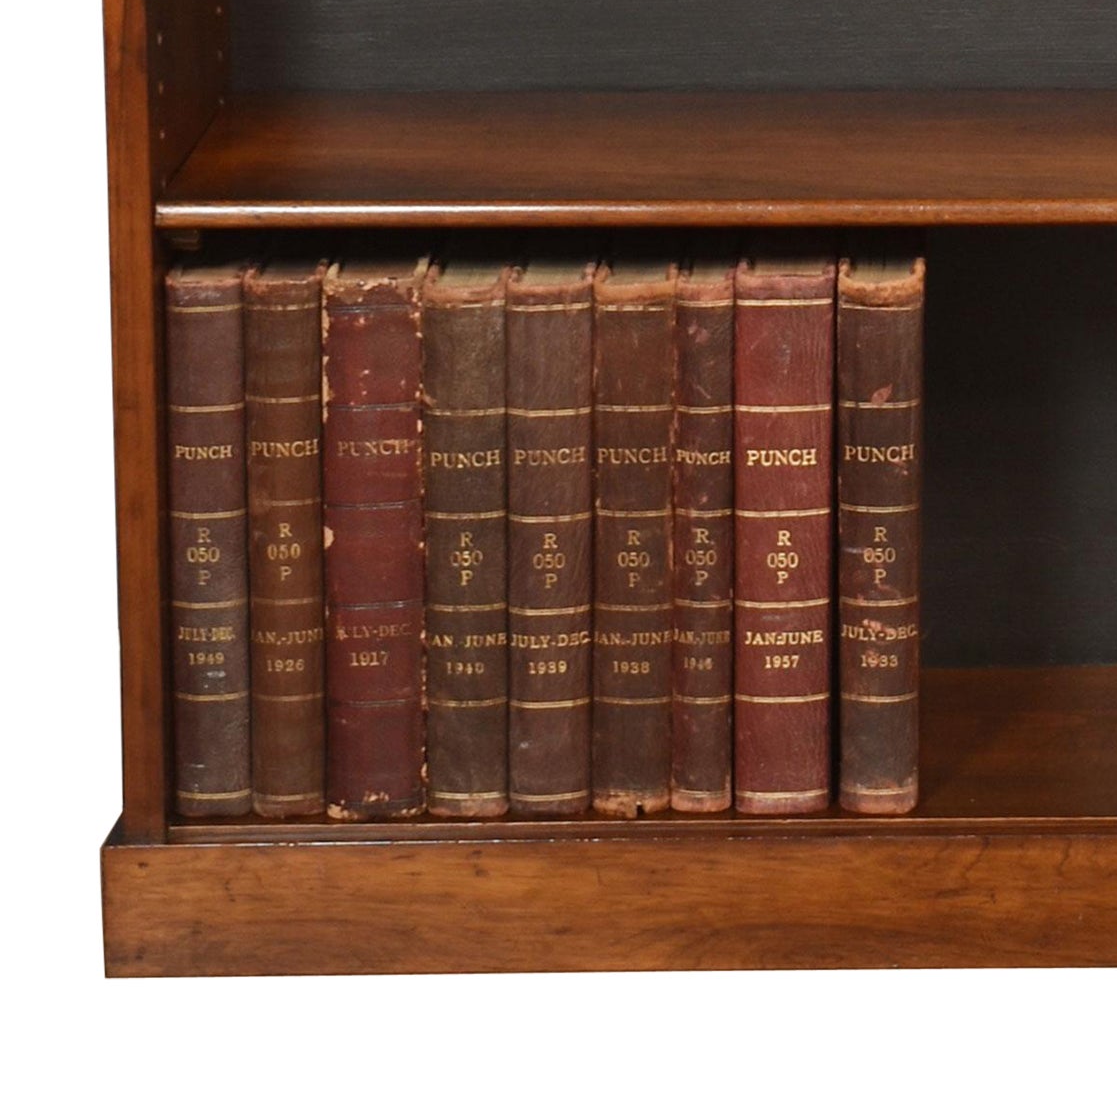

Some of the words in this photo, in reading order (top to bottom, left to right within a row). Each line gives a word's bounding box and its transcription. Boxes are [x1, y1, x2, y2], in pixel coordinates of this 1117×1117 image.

[175, 444, 232, 460] PUNCH
[251, 438, 319, 458] PUNCH
[337, 439, 410, 457] PUNCH
[514, 446, 586, 466] PUNCH
[598, 447, 667, 465] PUNCH
[844, 444, 915, 463] PUNCH
[430, 449, 500, 469] PUNCH
[676, 448, 731, 466] PUNCH
[747, 448, 817, 466] PUNCH
[197, 527, 211, 543] R
[279, 522, 292, 538] R
[628, 530, 640, 545] R
[777, 530, 791, 546] R
[874, 527, 887, 542] R
[460, 532, 474, 548] R
[543, 533, 558, 549] R
[187, 547, 220, 563] 050
[267, 543, 301, 559] 050
[450, 550, 483, 567] 050
[685, 550, 717, 566] 050
[863, 547, 896, 563] 050
[532, 553, 566, 569] 050
[617, 552, 650, 567] 050
[767, 552, 799, 568] 050
[198, 570, 211, 585] P
[280, 566, 292, 581] P
[460, 570, 473, 586] P
[544, 573, 557, 588] P
[628, 572, 640, 587] P
[695, 571, 709, 585] P
[777, 571, 789, 584] P
[875, 569, 887, 584] P
[252, 626, 323, 646] AN.-JUN
[188, 652, 225, 666] 1949
[266, 659, 305, 672] 1926
[350, 651, 390, 667] 1917
[764, 655, 800, 668] 1957
[528, 660, 568, 675] 1939
[613, 661, 650, 674] 1938
